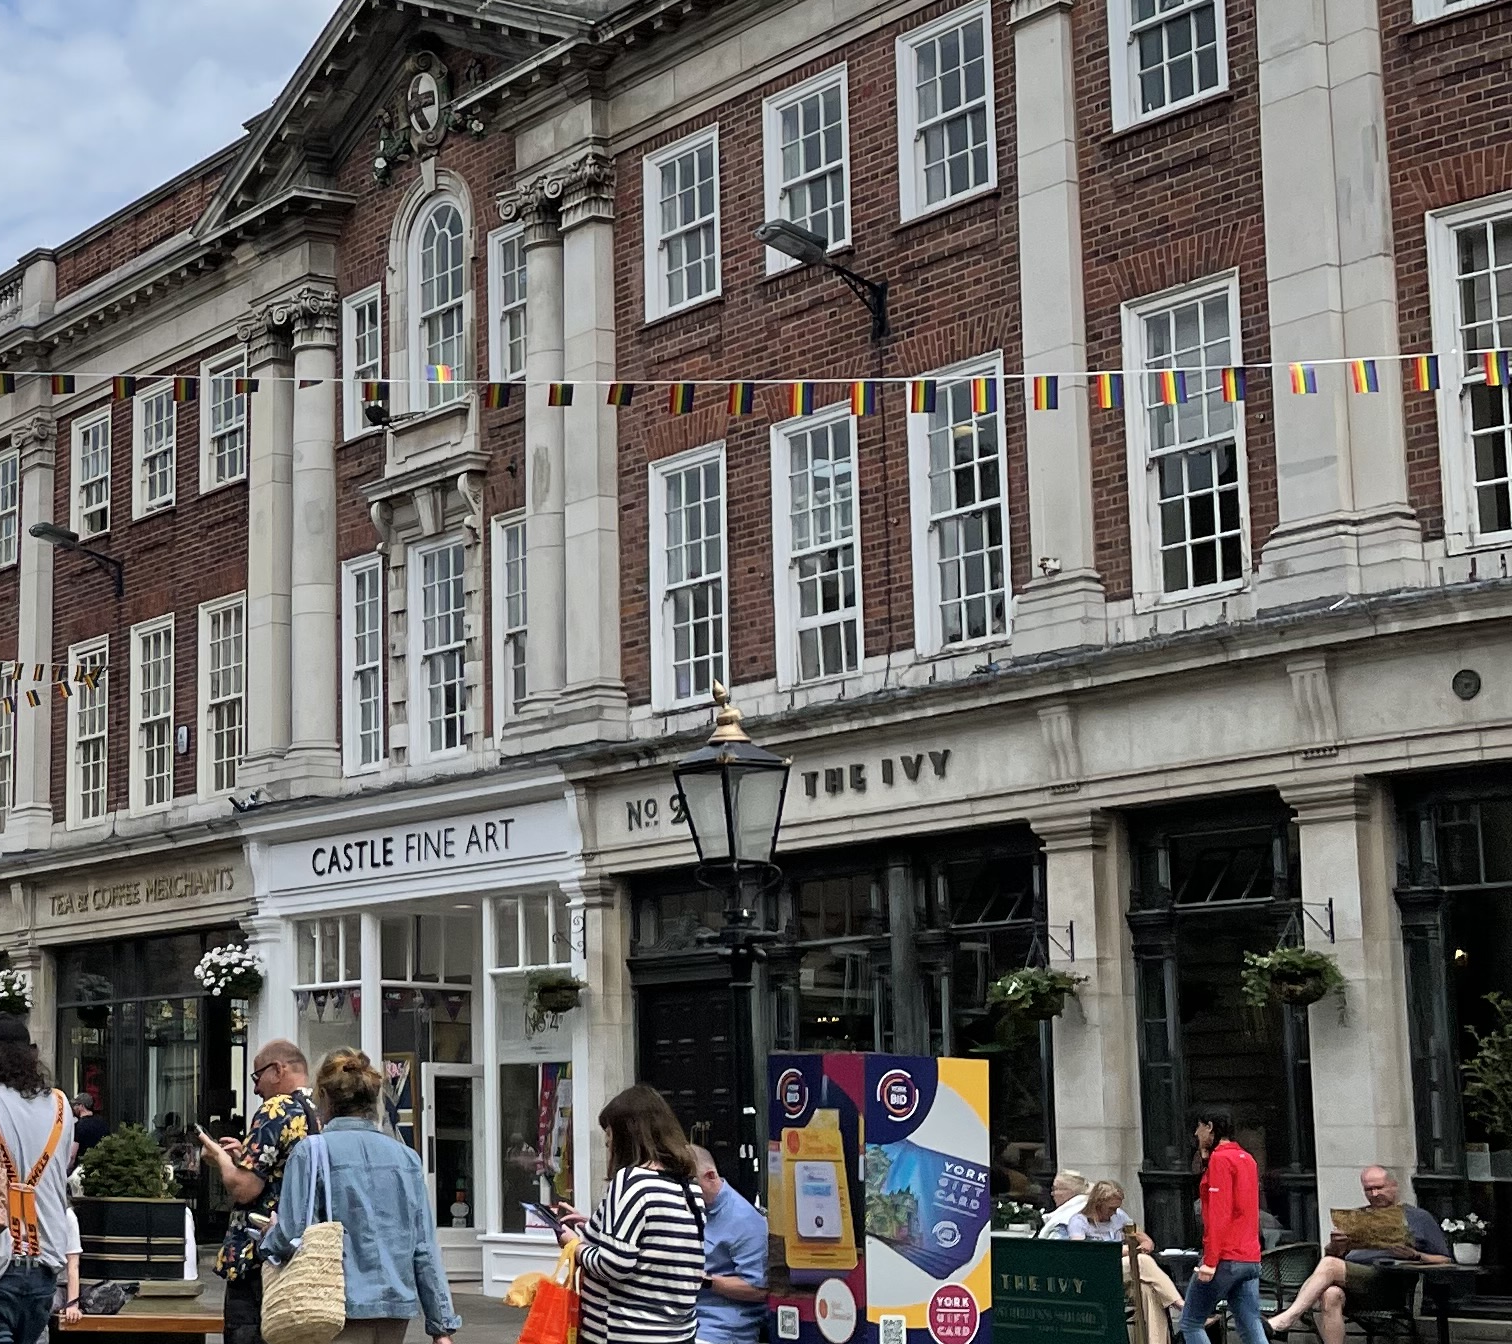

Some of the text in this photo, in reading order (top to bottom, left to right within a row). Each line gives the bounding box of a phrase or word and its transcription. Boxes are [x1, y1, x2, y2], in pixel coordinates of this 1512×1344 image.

[801, 770, 866, 798] THE
[881, 749, 951, 786] IVY
[312, 818, 515, 877] CASTLE FINE ART
[49, 892, 75, 917] TEA
[92, 881, 141, 911] COFFEE
[144, 866, 235, 904] MERCHANTS
[890, 1094, 908, 1106] BID
[945, 1161, 988, 1183] YORK
[938, 1177, 985, 1198] GIFT
[935, 1189, 980, 1210] CARD
[1001, 1274, 1087, 1294] THE IVY
[936, 1297, 970, 1307] YORK
[936, 1313, 970, 1324] GIFT
[937, 1326, 971, 1337] CARD
